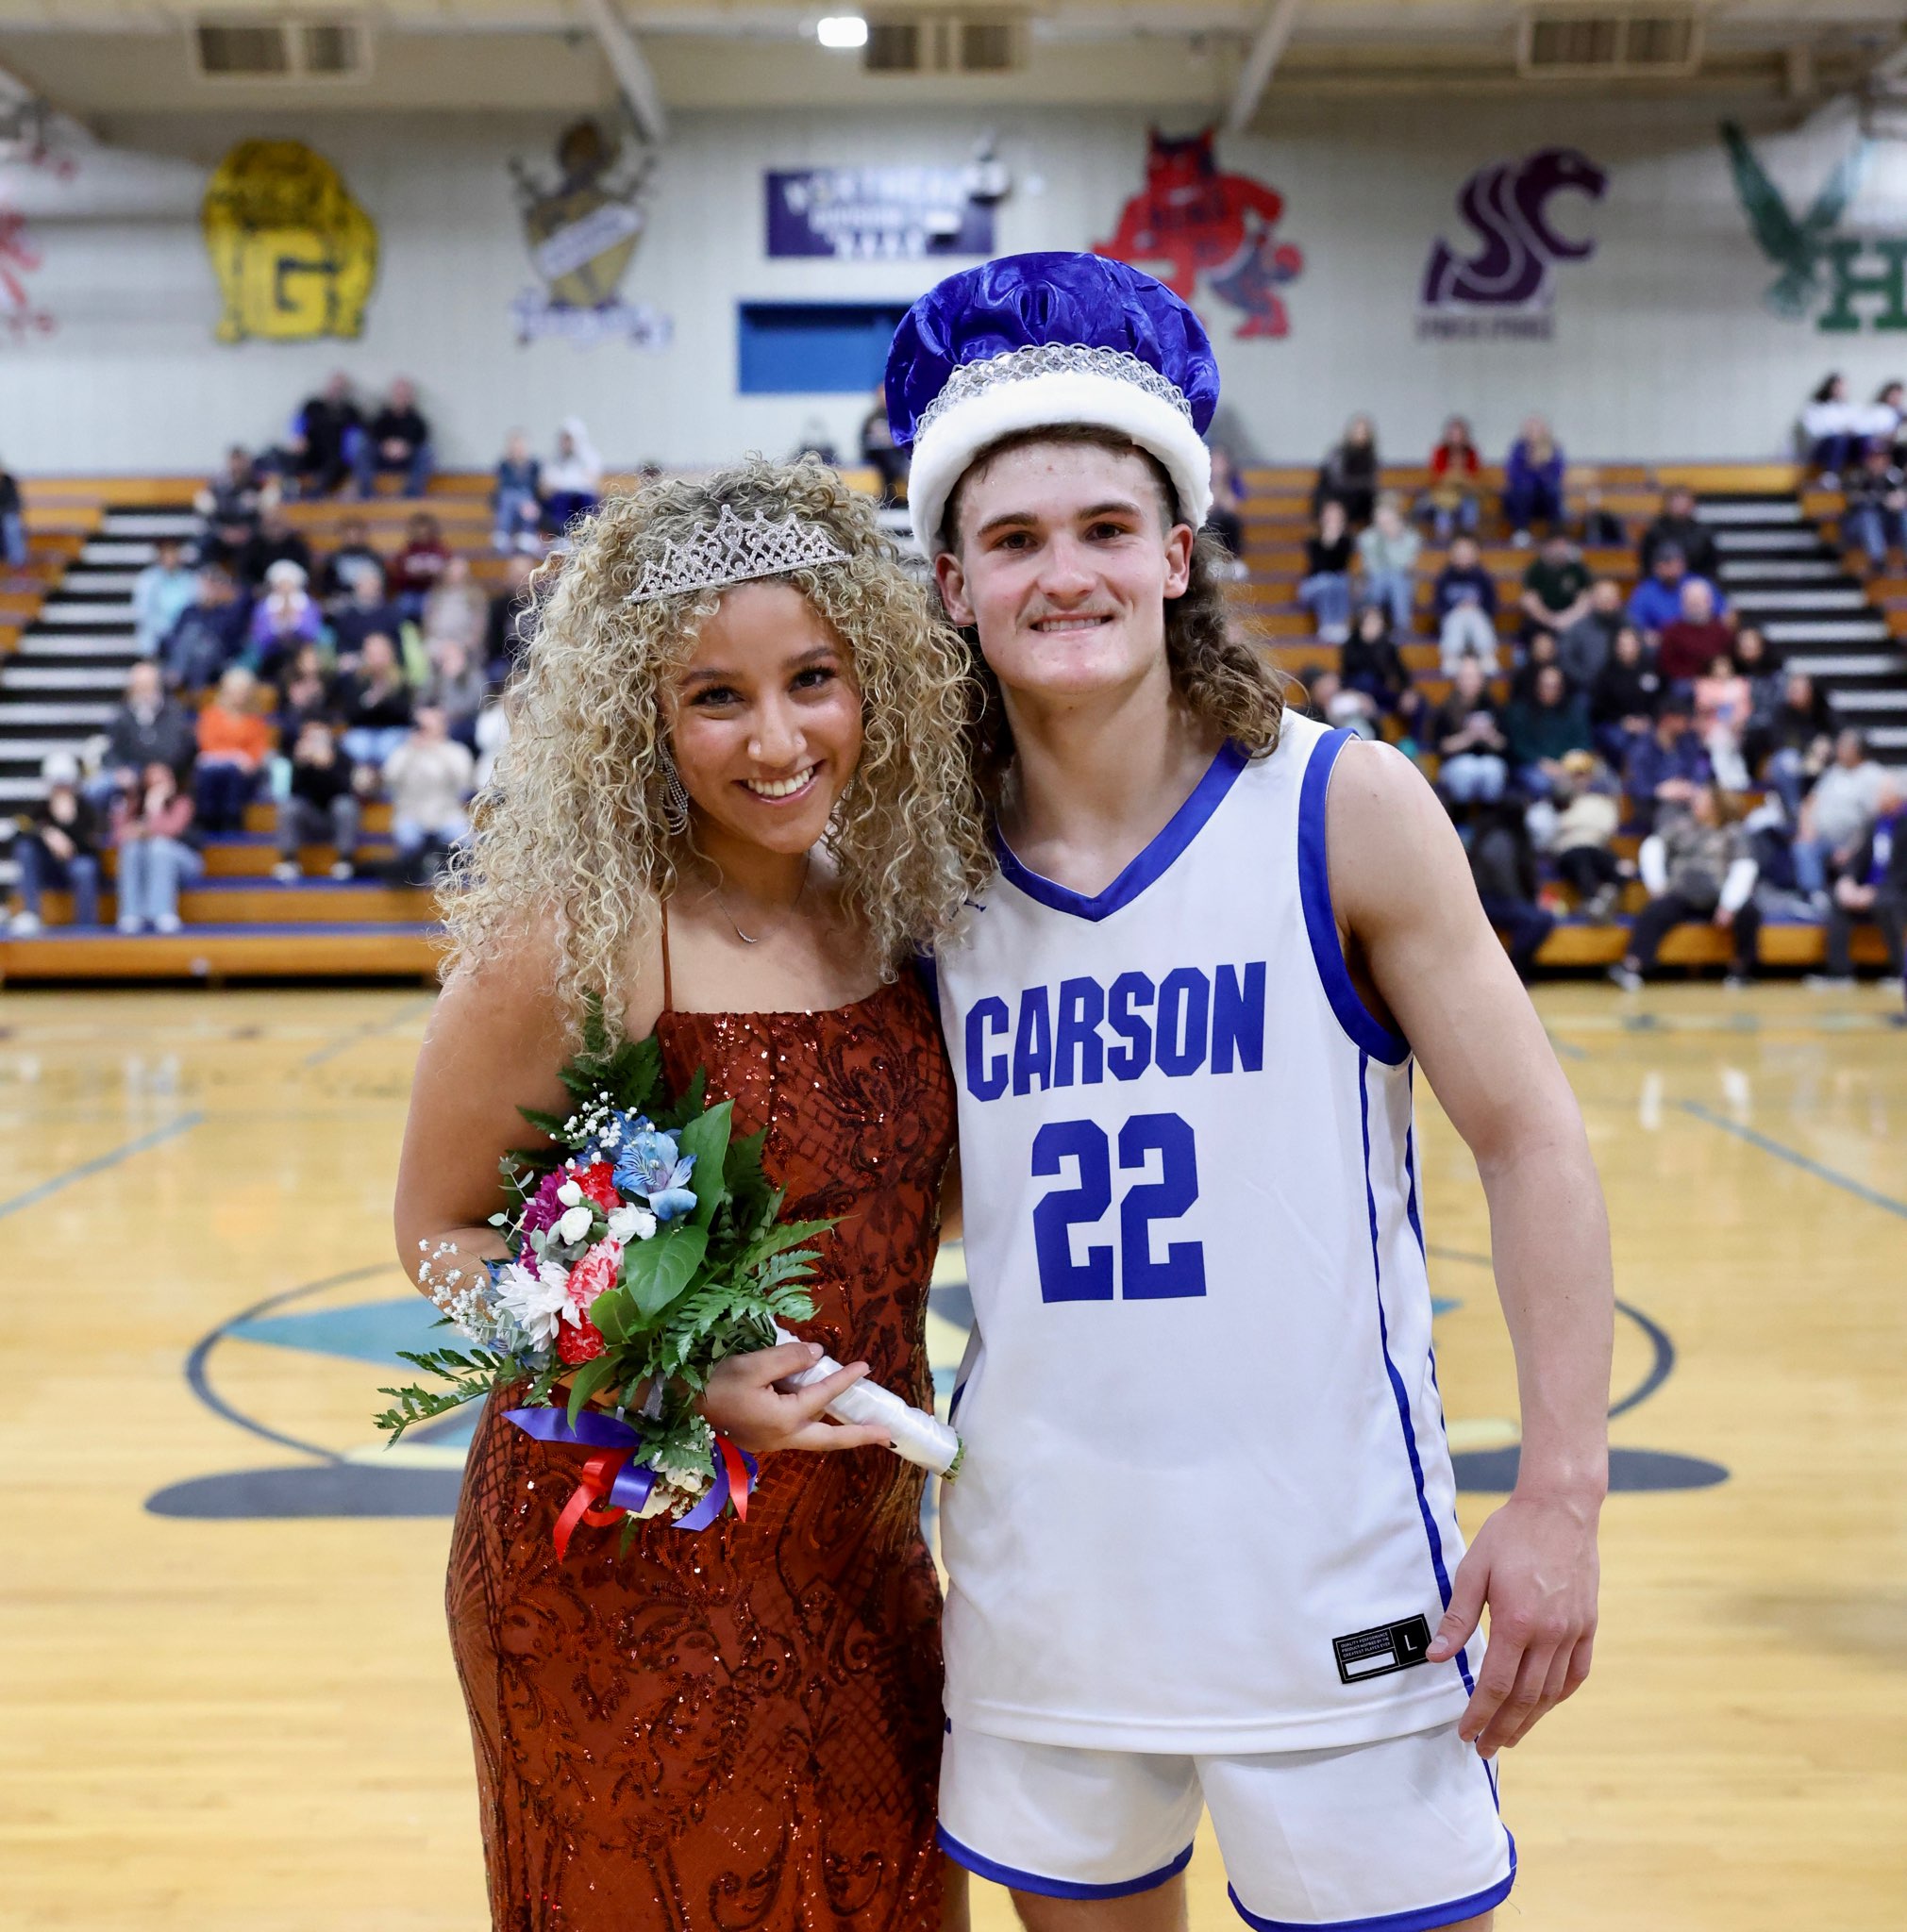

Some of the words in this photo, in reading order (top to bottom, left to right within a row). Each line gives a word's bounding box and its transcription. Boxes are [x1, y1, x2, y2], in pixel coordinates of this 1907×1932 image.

[241, 228, 328, 337] G
[1816, 239, 1907, 332] H
[965, 961, 1266, 1102] CARSON
[1031, 1112, 1207, 1303] 22
[1341, 1644, 1361, 1653] PRODUCT
[1343, 1648, 1364, 1657] GREATEST
[1364, 1643, 1380, 1652] PLAYER
[1359, 1632, 1388, 1642] PERFORMANCE
[1404, 1635, 1417, 1651] L
